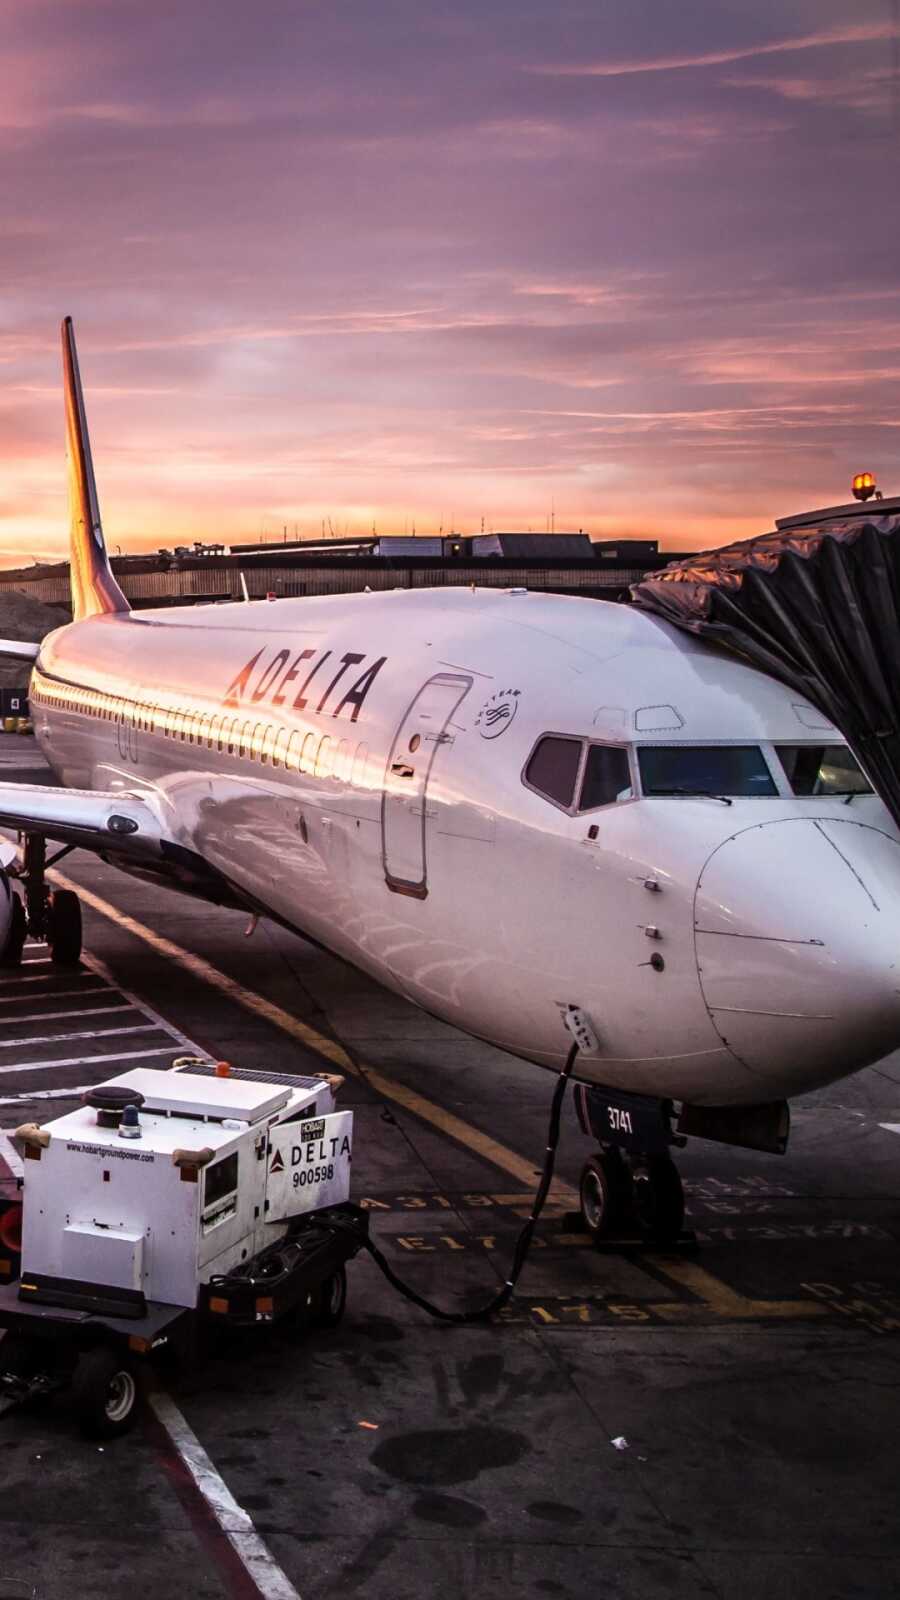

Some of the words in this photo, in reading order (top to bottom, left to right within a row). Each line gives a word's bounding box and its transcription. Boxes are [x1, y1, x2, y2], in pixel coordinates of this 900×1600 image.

[250, 649, 387, 723] DELTA
[608, 1106, 633, 1134] 3741
[66, 1143, 155, 1162] www.hobartgroundpower.com
[291, 1136, 350, 1166] DELTA
[293, 1164, 334, 1188] 900598
